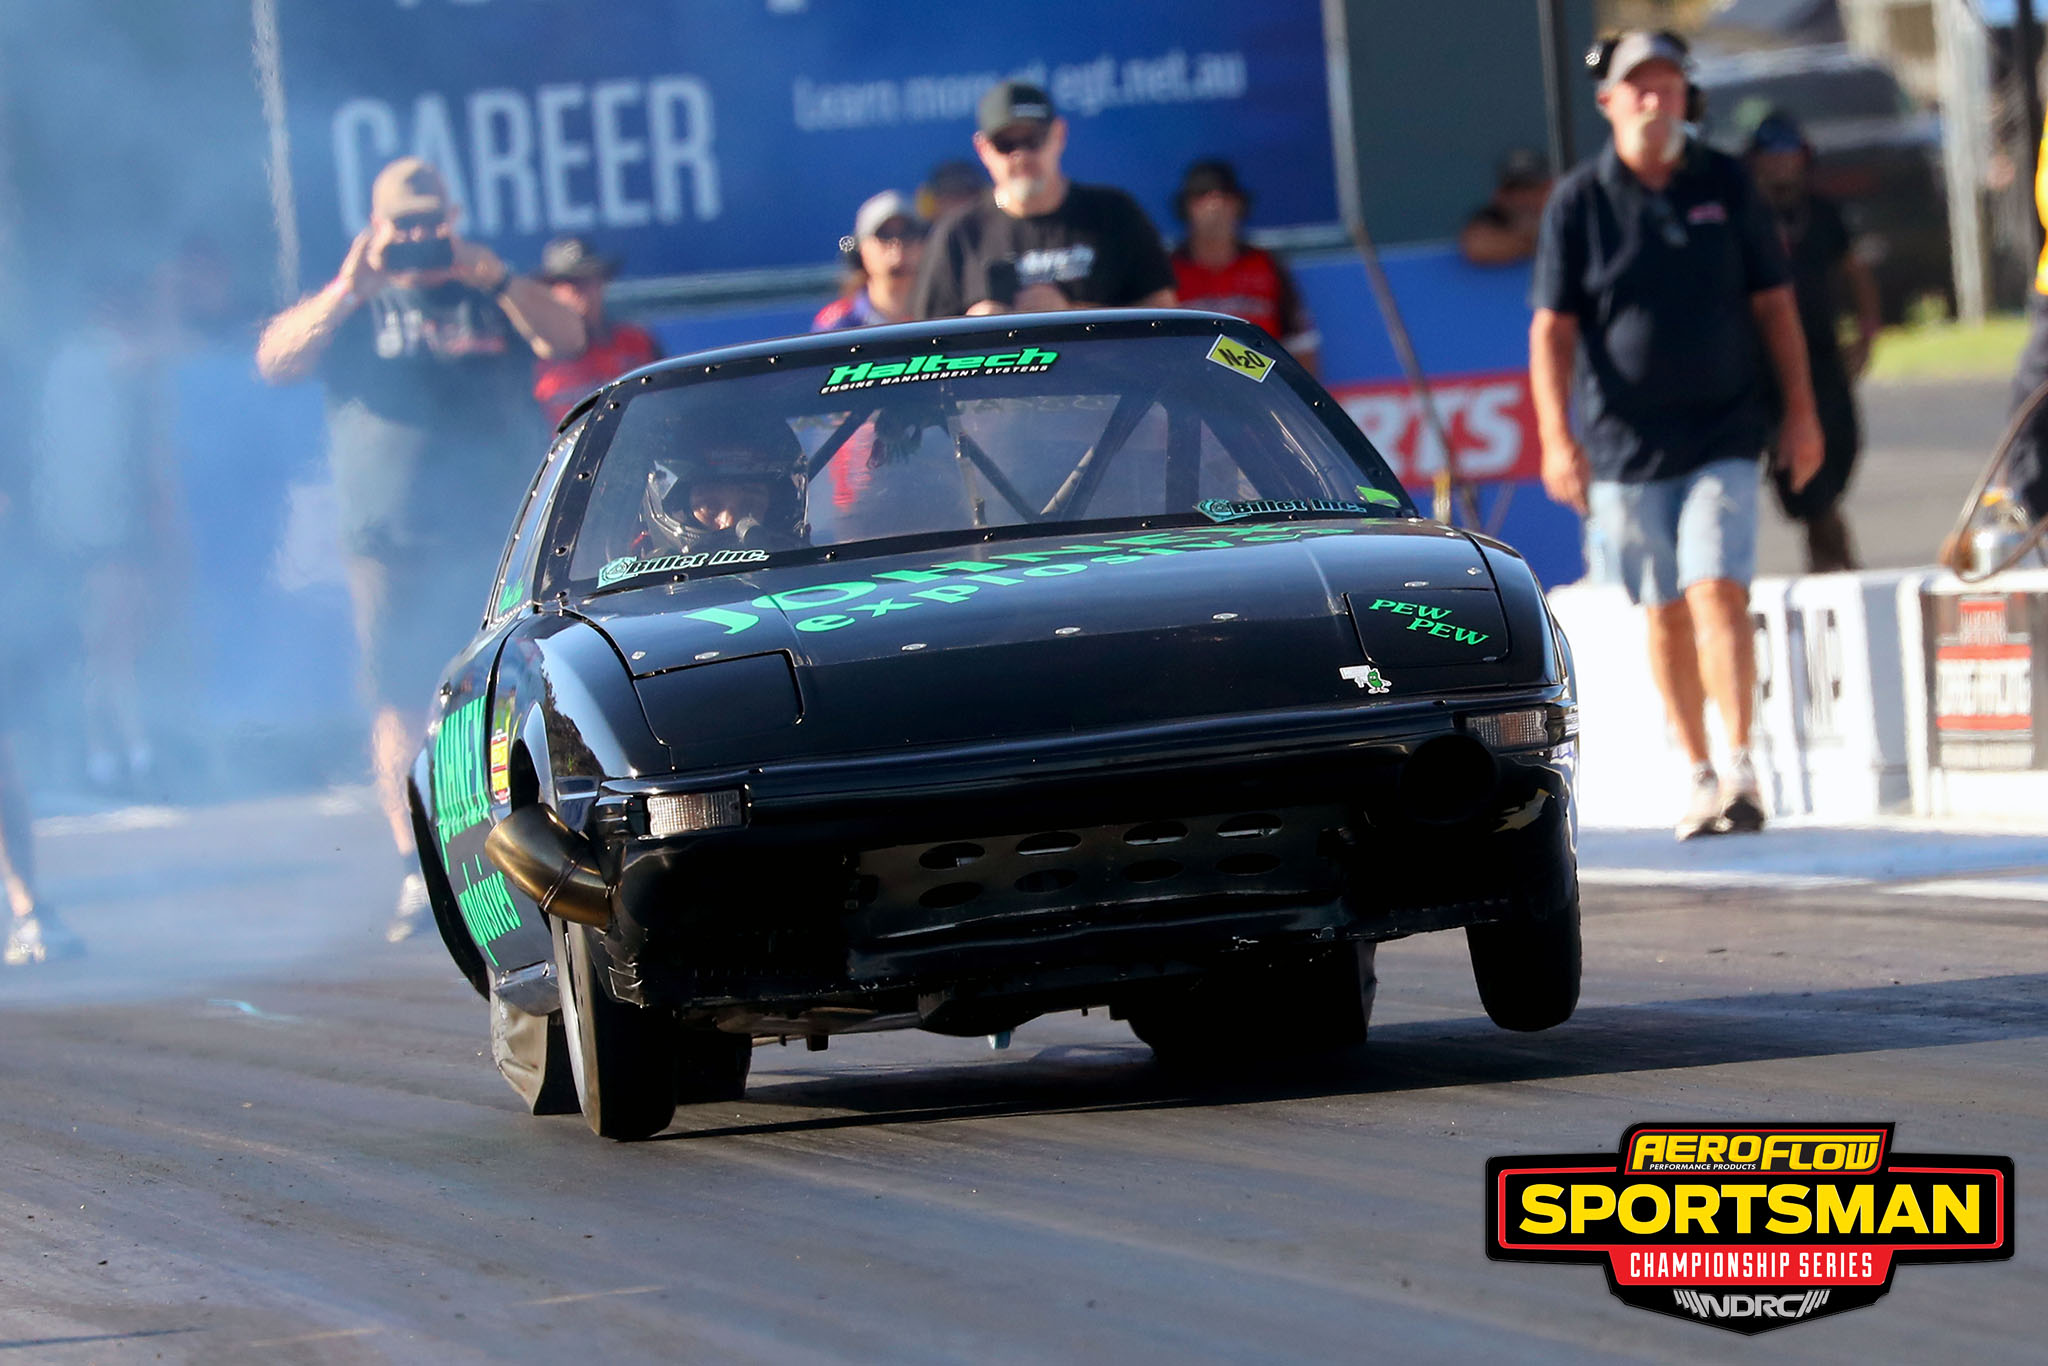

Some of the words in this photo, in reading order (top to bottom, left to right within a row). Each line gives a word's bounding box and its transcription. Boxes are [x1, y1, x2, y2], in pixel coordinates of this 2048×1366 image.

[331, 73, 723, 236] CAREER
[820, 380, 875, 394] ENGINE
[881, 369, 978, 385] MANAGEMENT
[985, 364, 1048, 374] SYSTEMS
[827, 348, 1058, 385] Haltech
[1230, 499, 1308, 516] Billet
[626, 553, 710, 575] Billet
[708, 549, 770, 566] Inc.
[682, 521, 1318, 635] JOHNEX
[795, 528, 1354, 632] explosives
[1368, 598, 1453, 620] PEW
[1406, 617, 1490, 646] PEW
